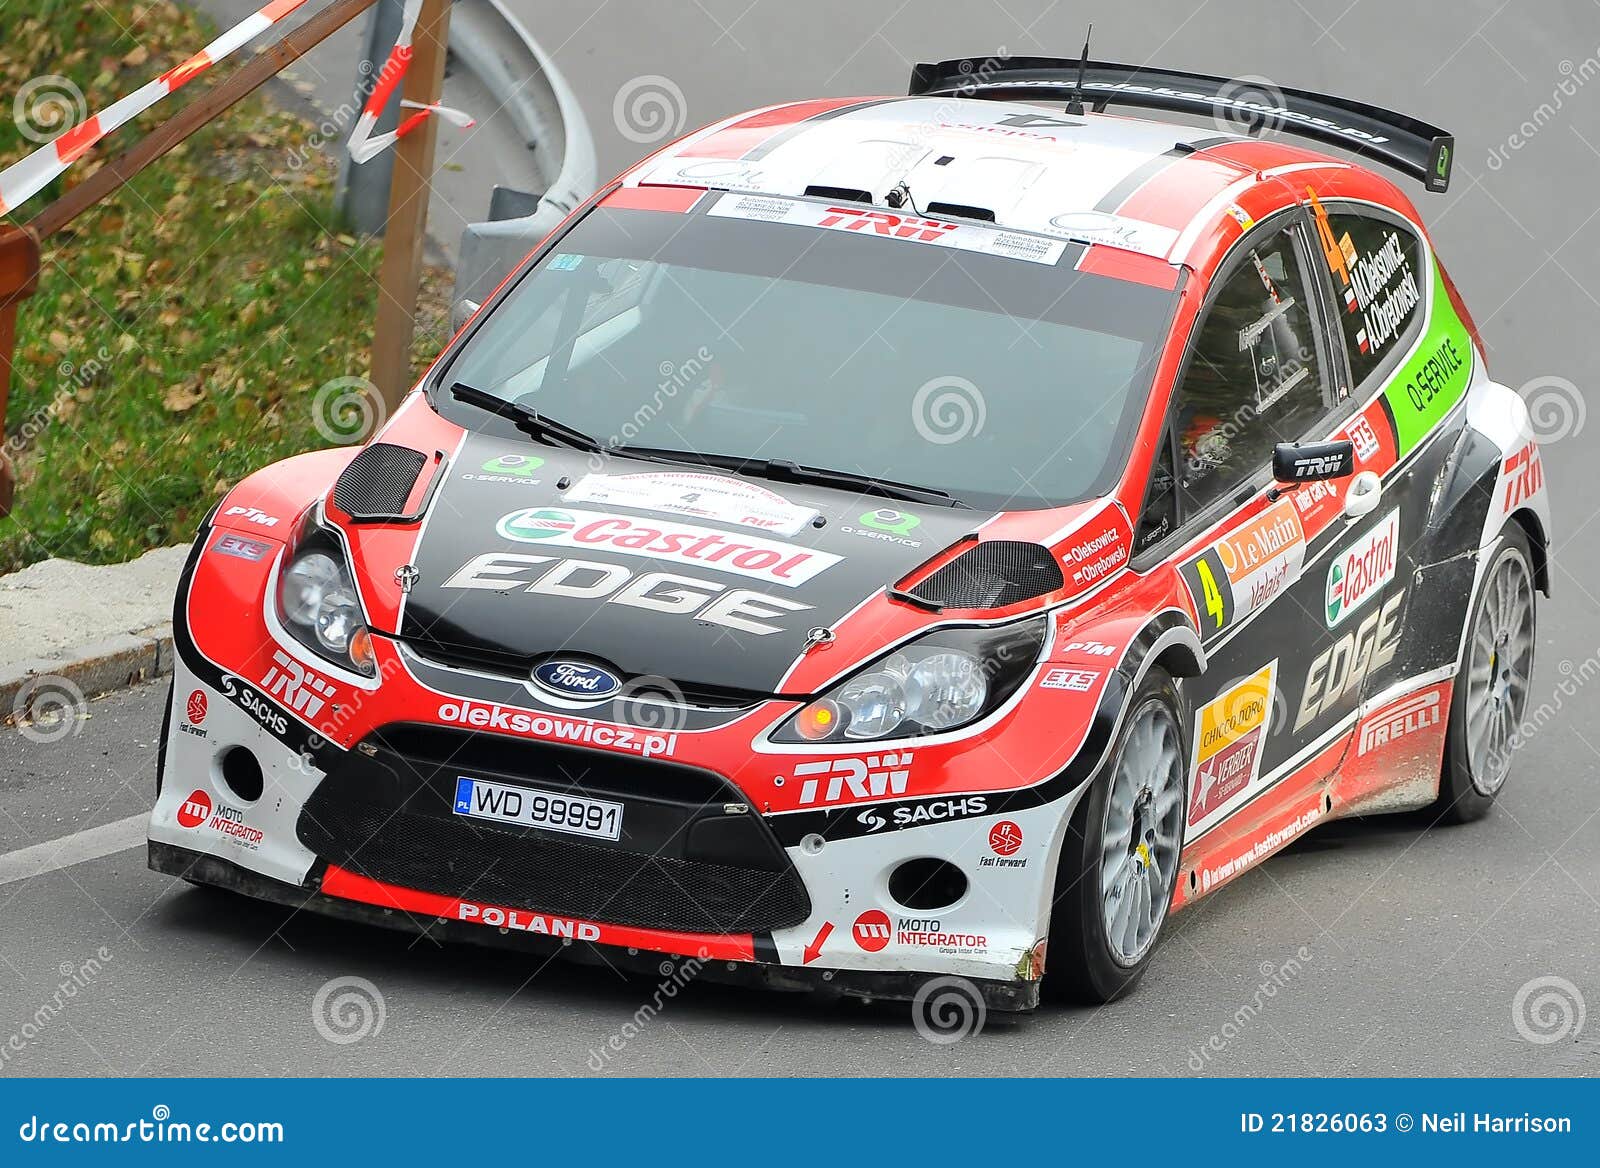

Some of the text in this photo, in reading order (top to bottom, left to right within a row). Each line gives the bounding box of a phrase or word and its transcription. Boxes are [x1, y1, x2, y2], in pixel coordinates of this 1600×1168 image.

[818, 207, 959, 241] TRW
[1305, 185, 1350, 286] 4
[1349, 420, 1374, 450] ETS
[1294, 454, 1344, 477] TRW
[571, 516, 815, 582] Castrol
[1071, 528, 1119, 562] Oleksowicz
[1342, 519, 1395, 609] Castrol
[440, 552, 816, 636] EDGE
[1196, 558, 1225, 629] 4
[554, 664, 602, 691] Ford
[1046, 671, 1096, 685] ETS
[1293, 588, 1406, 735] EDGE
[260, 650, 338, 719] TRW
[239, 688, 289, 735] SACHS
[437, 701, 678, 757] oleksowicz.pl
[1358, 690, 1441, 757] PIRELLI
[793, 753, 914, 804] TRW
[215, 804, 244, 824] MOTO
[457, 800, 469, 810] PL
[475, 785, 618, 835] WD 99991
[893, 796, 987, 824] SACHS
[209, 817, 264, 844] INTEGRATOR
[979, 856, 1028, 868] Fast Forward
[458, 903, 601, 941] POLAND
[897, 932, 987, 948] INTEGRATOR
[898, 919, 940, 932] MOTO
